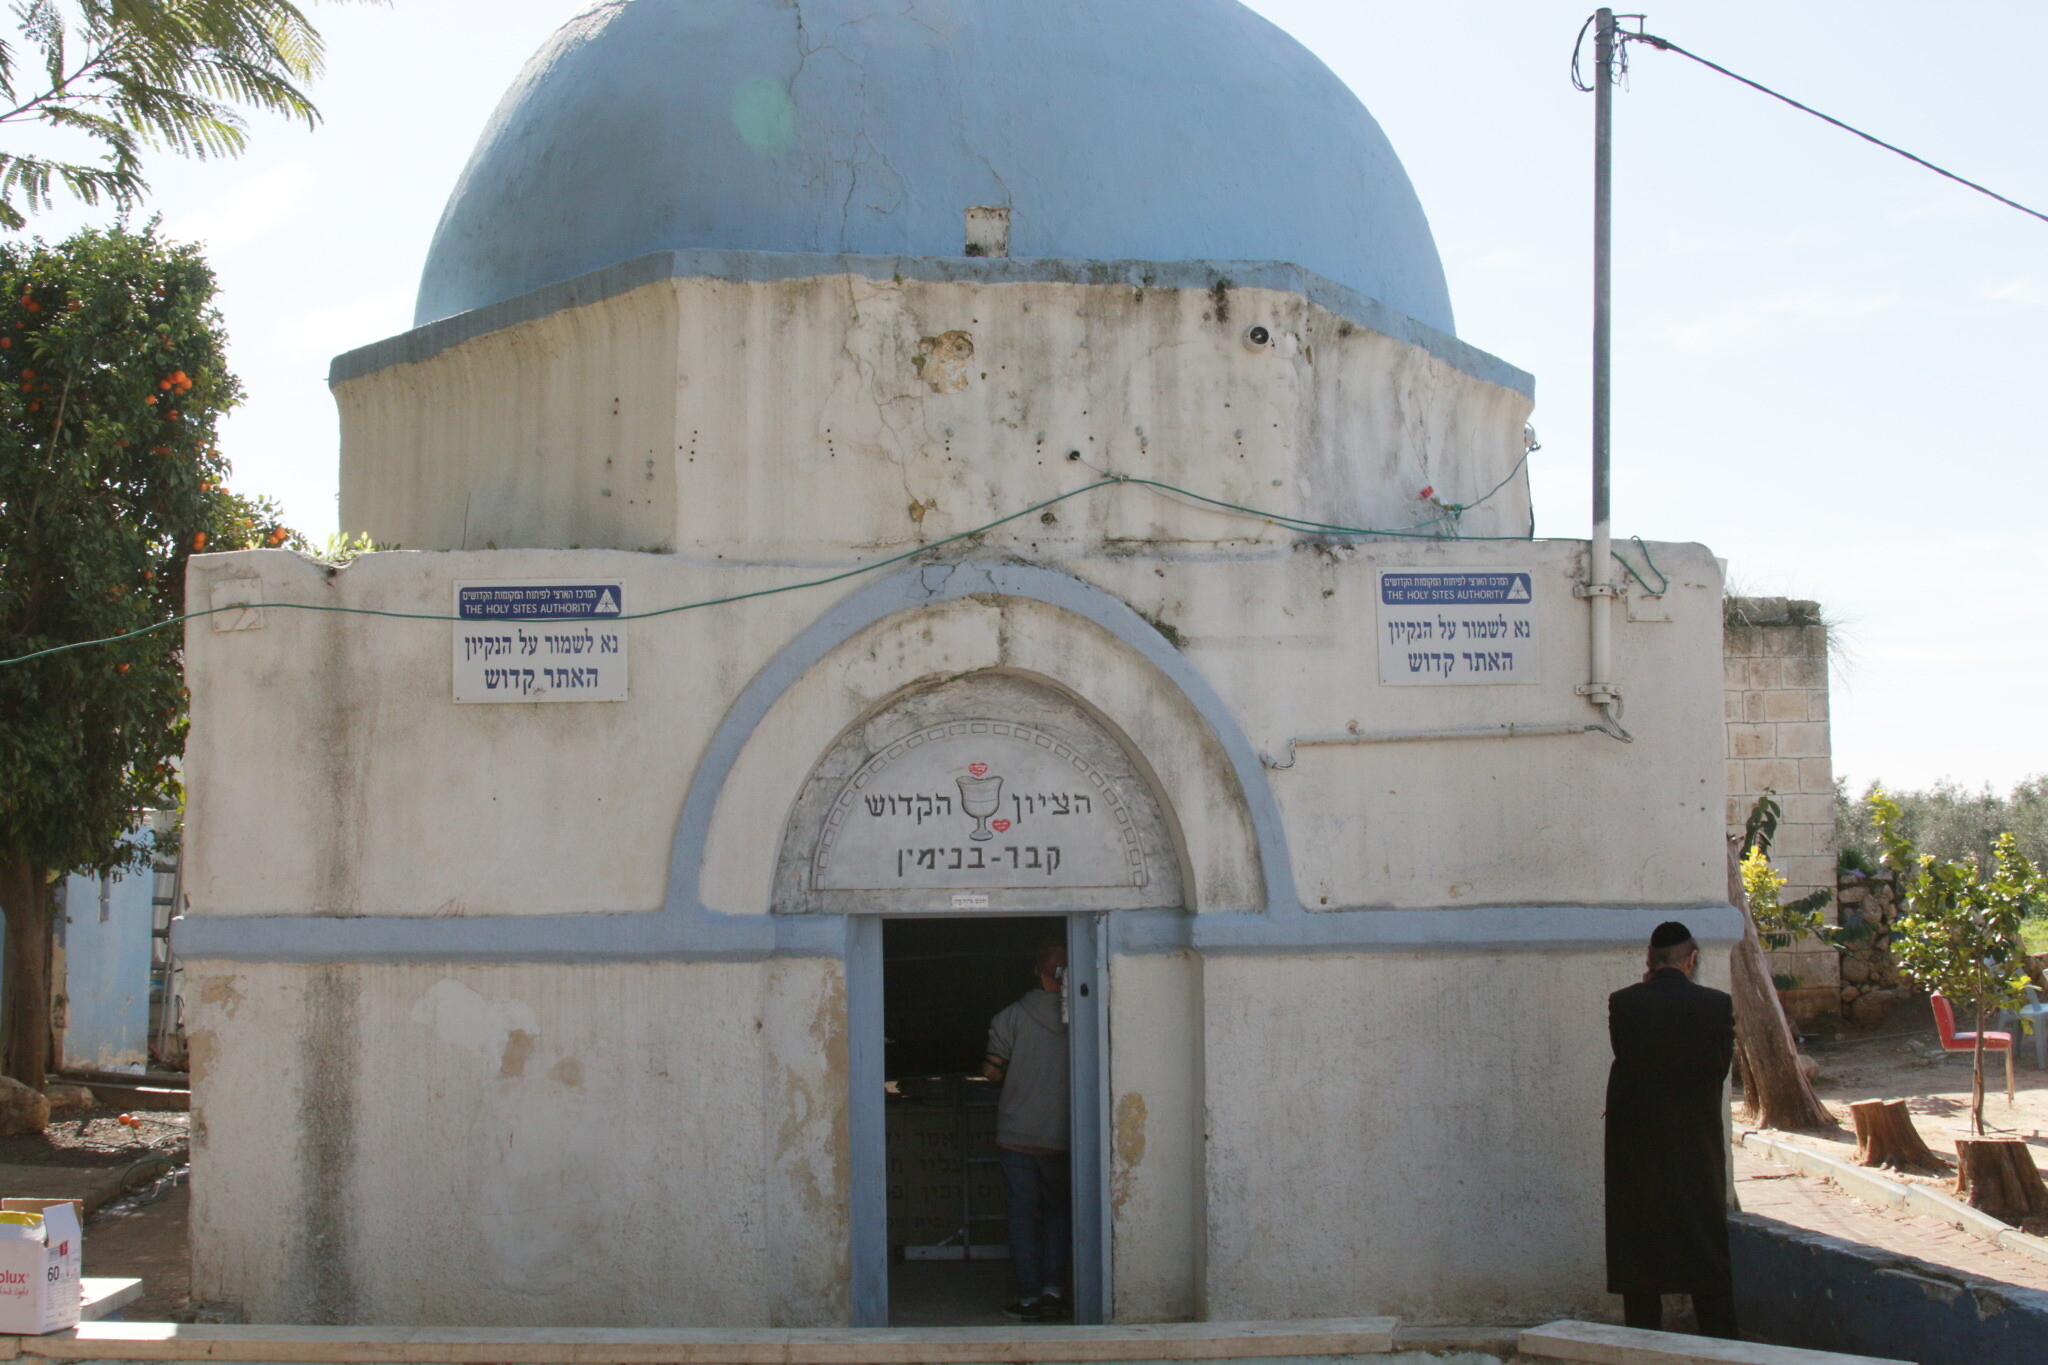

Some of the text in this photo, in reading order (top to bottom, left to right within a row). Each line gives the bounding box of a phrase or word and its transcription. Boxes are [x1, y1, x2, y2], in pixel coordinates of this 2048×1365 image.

[1384, 578, 1412, 588] הקדושים
[1414, 577, 1442, 589] המקומות
[1468, 577, 1487, 587] הארצי
[1489, 577, 1509, 586] המרכז
[462, 588, 597, 603] המרכז הארצי לפיתוח המקומות הקדושים
[1387, 590, 1504, 600] THE HOLY SITES AUTHORITY
[464, 603, 592, 614] THE HOLY SITES AUTHORITY
[1388, 613, 1531, 645] נא לשמור על הנקיון
[464, 627, 619, 661] נא לשמור על הנקיון
[1408, 651, 1513, 679] האתר קדוש
[484, 667, 599, 695] האתר קדוש
[865, 792, 1092, 825] הציון הקדוש
[48, 1265, 60, 1282] 60
